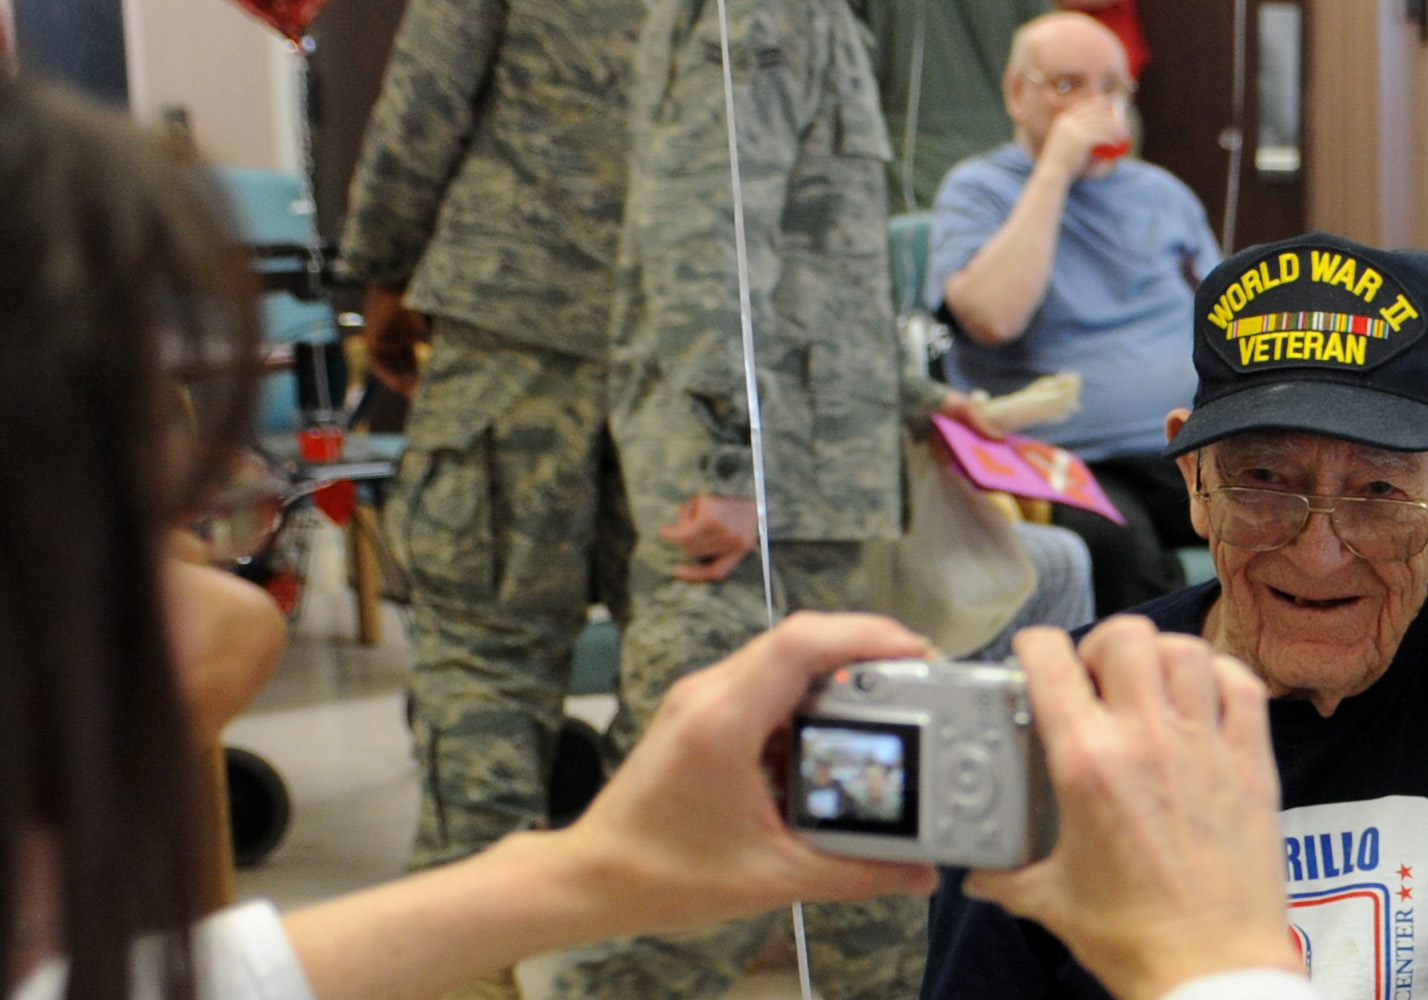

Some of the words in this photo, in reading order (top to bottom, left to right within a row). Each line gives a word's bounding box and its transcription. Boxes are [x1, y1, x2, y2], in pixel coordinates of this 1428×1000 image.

[1207, 253, 1300, 329] WORLD
[1310, 250, 1384, 302] WAR
[1379, 294, 1419, 332] II
[1239, 331, 1367, 366] VETERAN
[1285, 826, 1379, 882] RILLO
